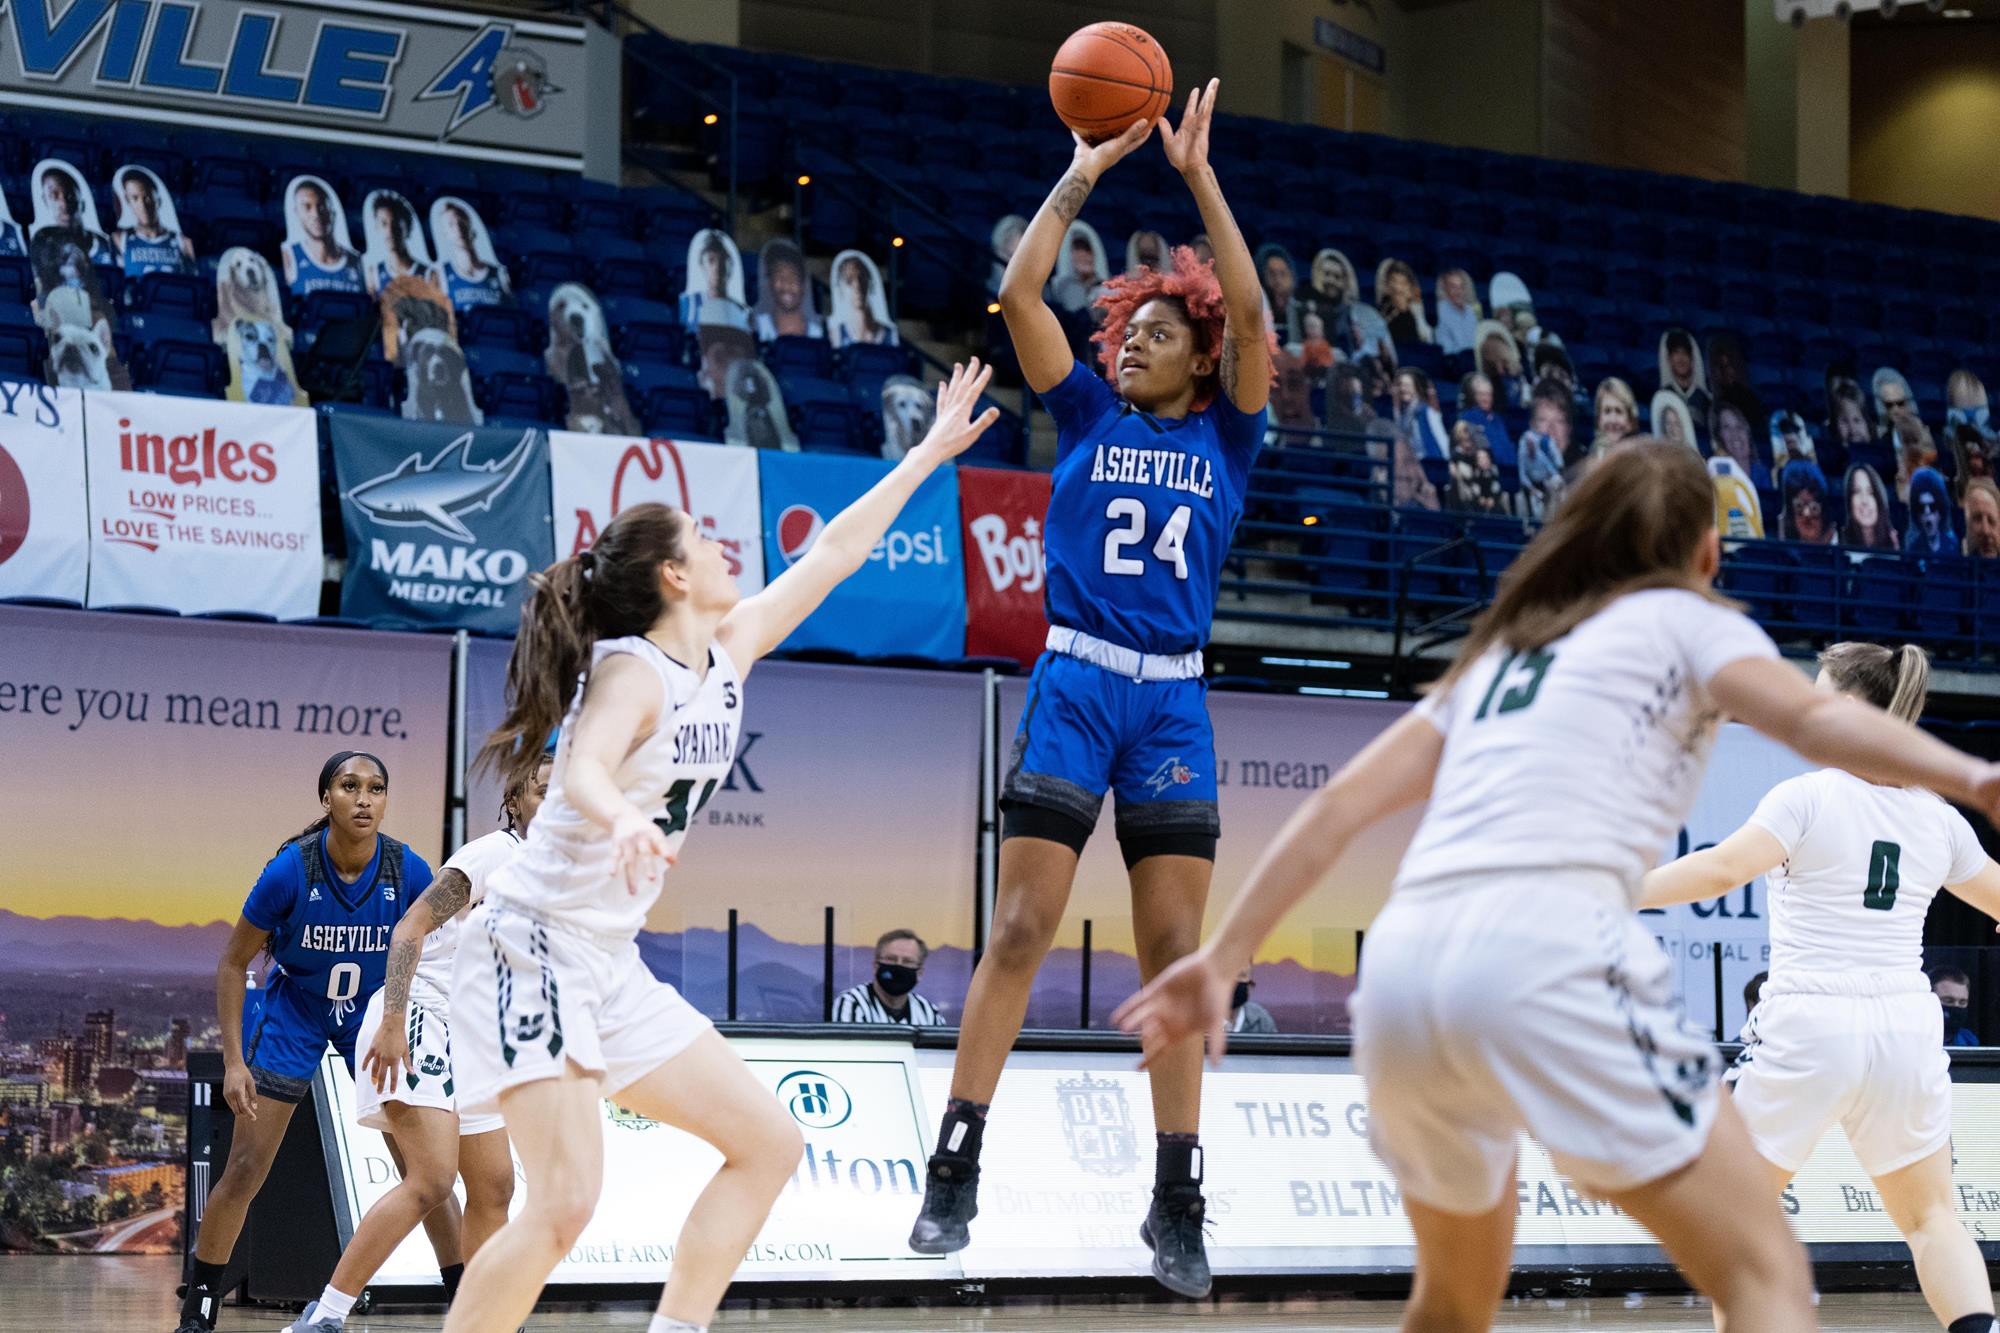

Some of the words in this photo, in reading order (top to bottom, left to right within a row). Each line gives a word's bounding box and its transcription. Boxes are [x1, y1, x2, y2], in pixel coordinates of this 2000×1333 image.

[118, 418, 277, 487] ingles
[1090, 444, 1214, 499] ASHEVILLE
[129, 489, 176, 510] LOW
[103, 517, 159, 539] LOVE
[164, 523, 205, 545] THE
[868, 524, 946, 571] epsi
[970, 513, 1046, 592] Boj
[1103, 497, 1192, 580] 24
[371, 537, 528, 585] MAKO
[388, 579, 505, 608] MEDICAL
[68, 688, 149, 731] you
[164, 694, 281, 730] mean
[294, 702, 407, 740] more.
[1241, 758, 1329, 789] mean
[709, 811, 764, 827] BANK
[1863, 840, 1900, 911] 0
[327, 962, 361, 1001] 0
[1235, 1102, 1331, 1137] THIS
[790, 1143, 923, 1196] lton
